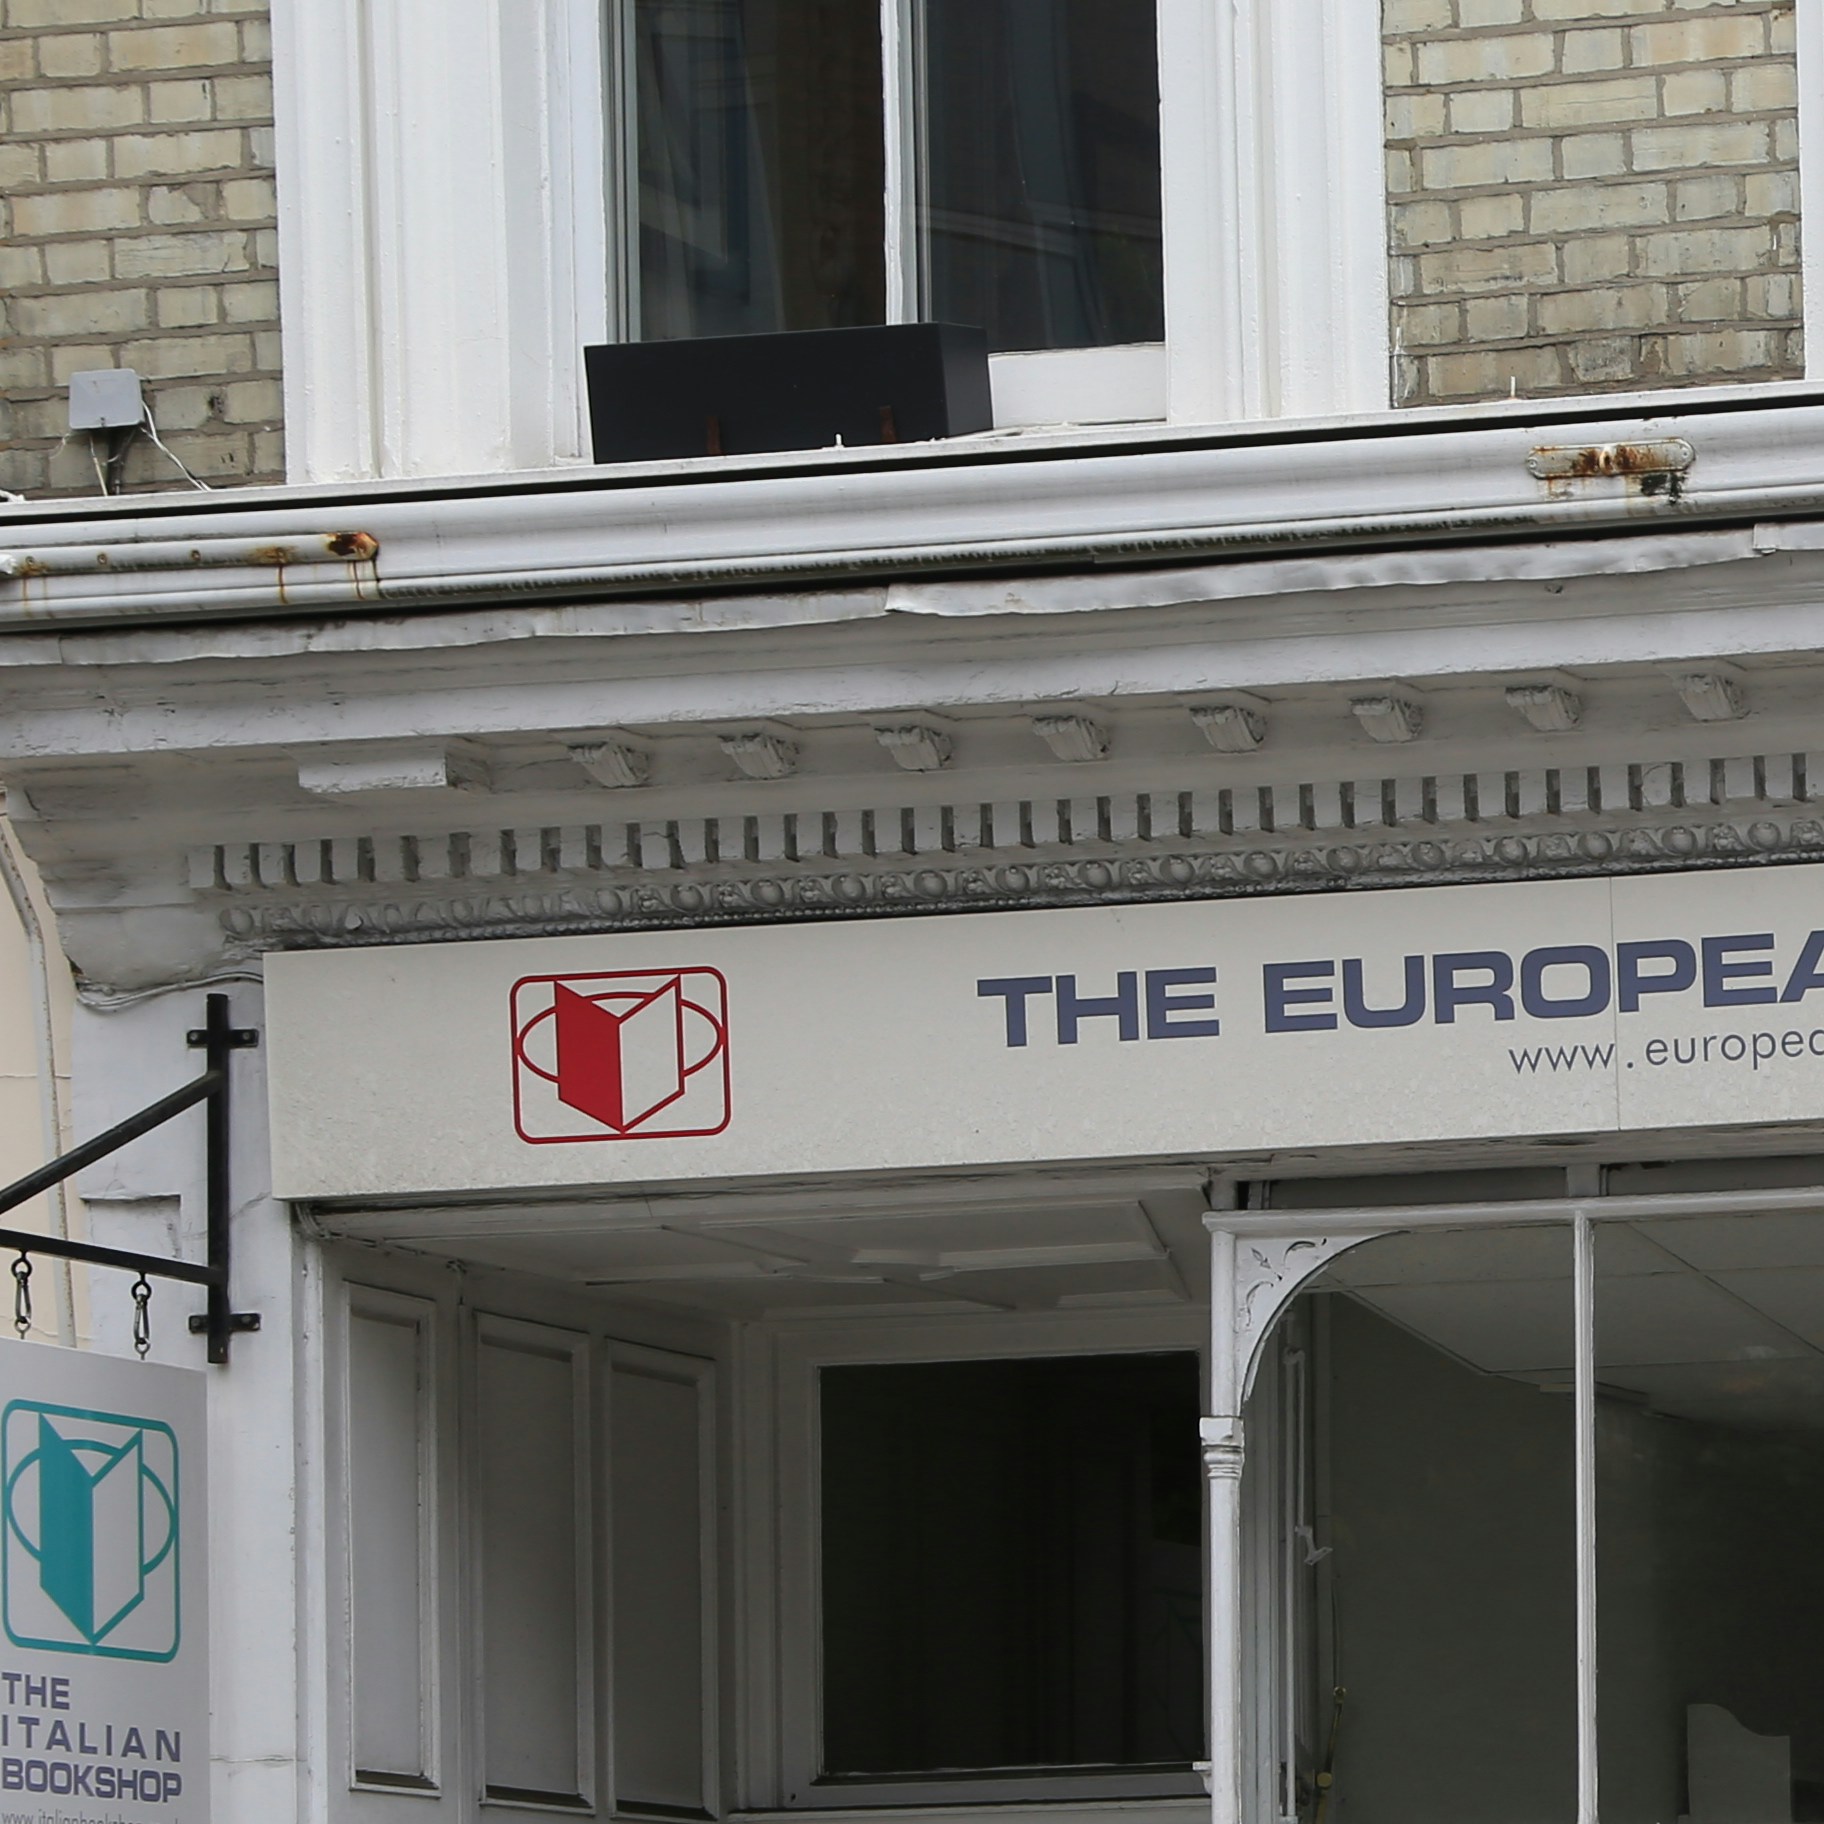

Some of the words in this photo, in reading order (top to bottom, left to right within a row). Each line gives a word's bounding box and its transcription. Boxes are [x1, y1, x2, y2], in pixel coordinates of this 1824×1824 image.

[976, 966, 1221, 1048] THE
[1, 1672, 70, 1710] THE
[2, 1714, 181, 1763] ITALIAN
[2, 1757, 183, 1804] BOOKSHOP
